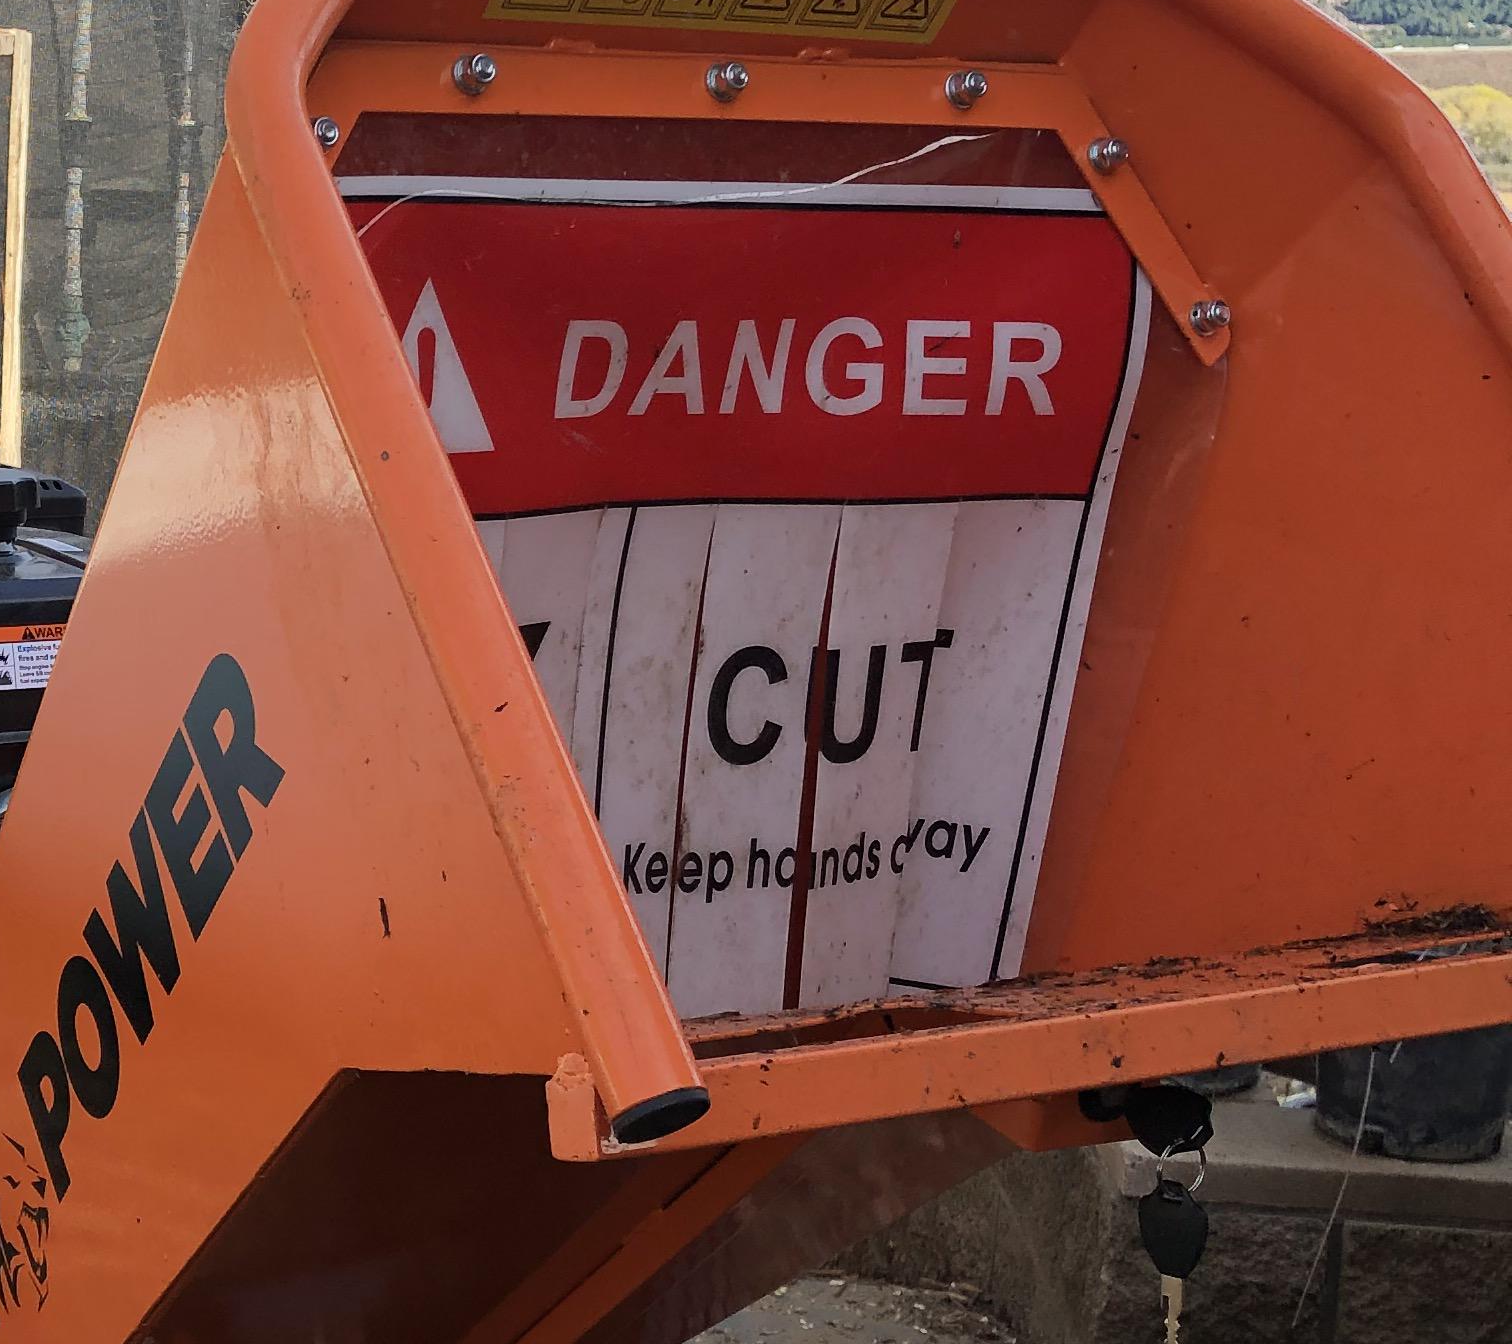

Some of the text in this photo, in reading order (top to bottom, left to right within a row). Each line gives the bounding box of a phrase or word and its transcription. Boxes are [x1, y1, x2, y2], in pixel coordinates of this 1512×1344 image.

[554, 317, 1063, 418] DANGER
[34, 626, 67, 638] WAR
[707, 628, 954, 765] CUT
[623, 842, 734, 903] Keep
[746, 831, 881, 890] hands
[17, 654, 286, 1203] POWER
